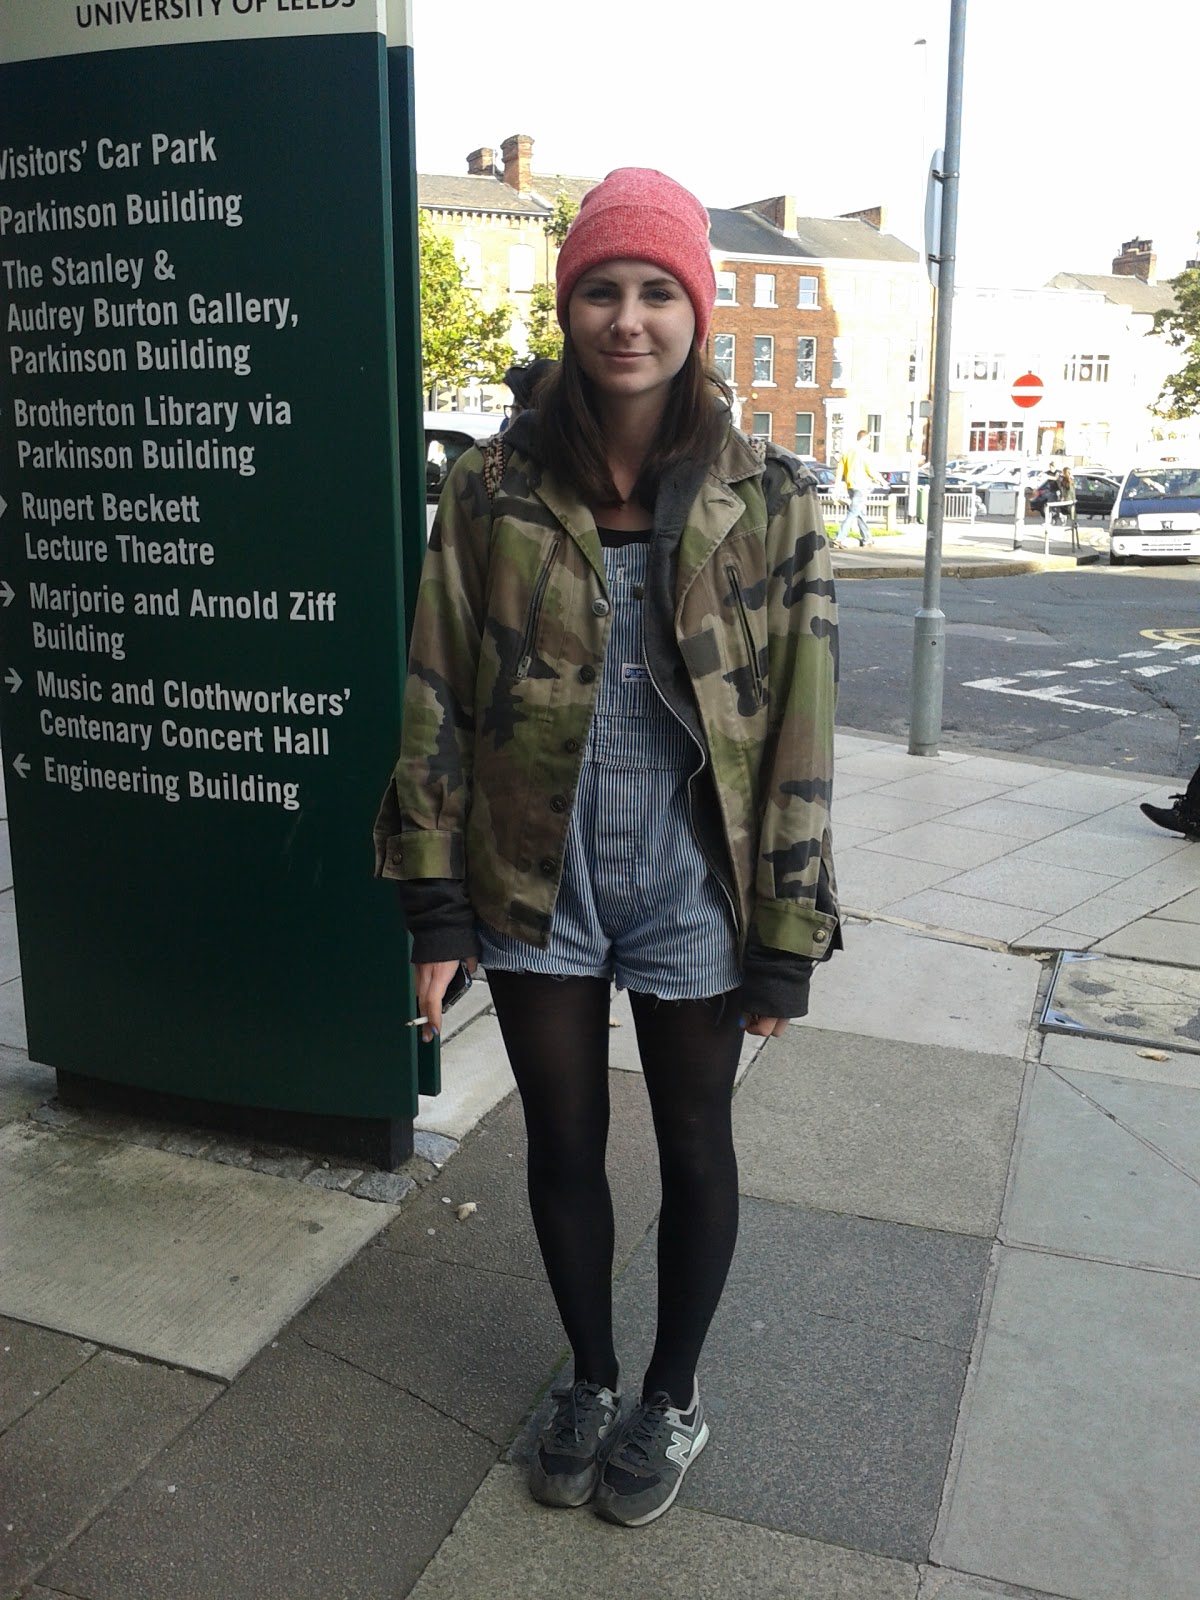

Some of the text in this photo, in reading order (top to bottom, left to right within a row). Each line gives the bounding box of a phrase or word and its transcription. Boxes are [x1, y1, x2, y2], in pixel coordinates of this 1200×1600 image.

[76, 0, 221, 28] UNIVERSITY
[0, 129, 218, 180] Visitors' Car Park
[0, 187, 243, 236] Parkinson Building
[2, 249, 176, 290] The Stanley &
[7, 291, 299, 337] Audrey Burton Gallery,
[9, 338, 252, 376] Parkinson Building
[14, 392, 292, 433] Brotherton Library via
[17, 438, 256, 477] Parkinson Building
[21, 491, 201, 527] Rupert Beckett
[24, 532, 215, 566] Lecture Theatre
[29, 581, 337, 622] Marjorie and Arnold Ziff
[32, 621, 126, 661] Building
[36, 670, 351, 717] Music and Clothworkers'
[39, 708, 330, 756] Centenary Concert Hall
[43, 756, 300, 811] Engineering Building
